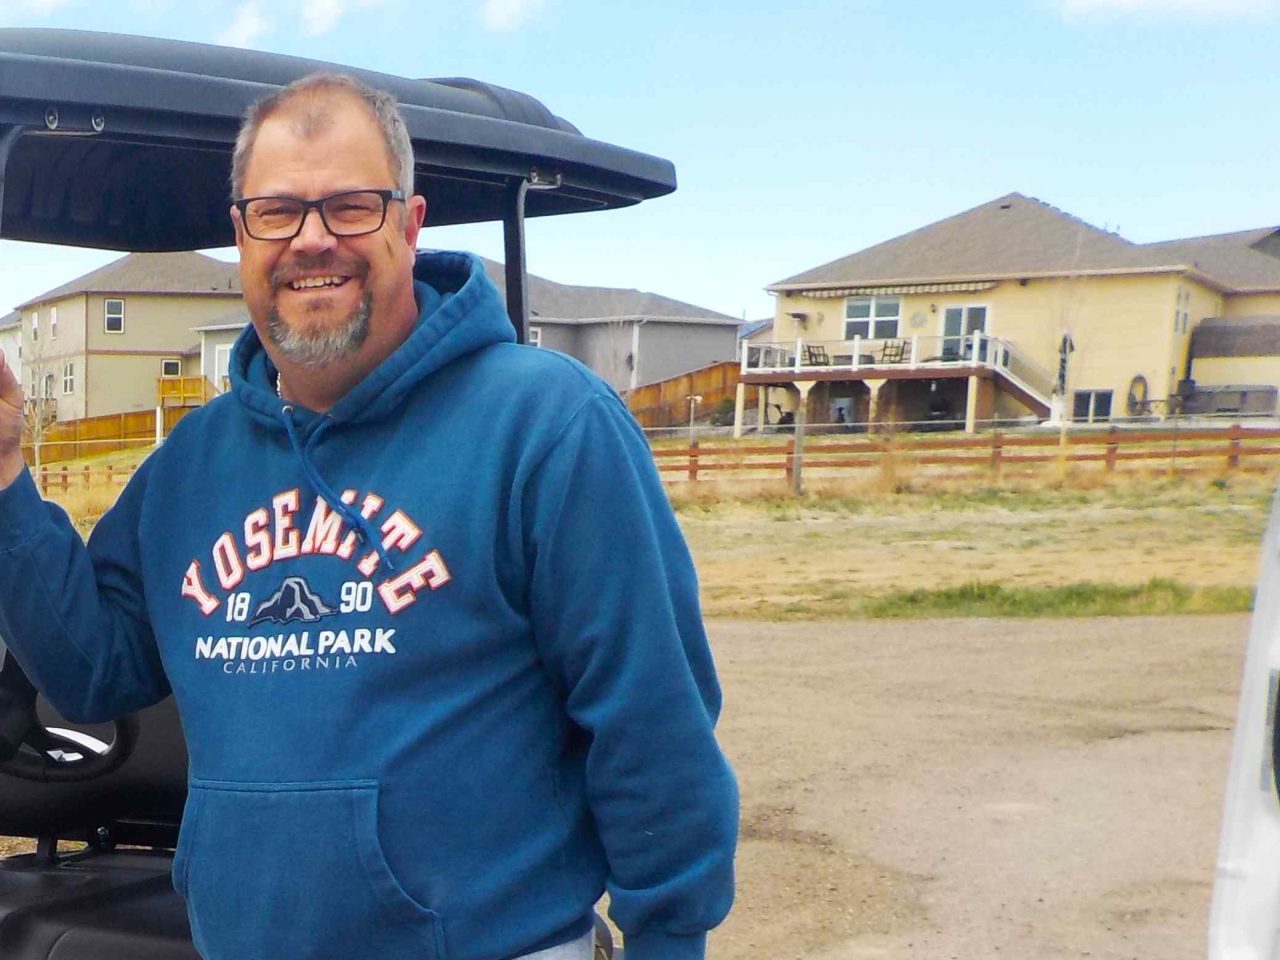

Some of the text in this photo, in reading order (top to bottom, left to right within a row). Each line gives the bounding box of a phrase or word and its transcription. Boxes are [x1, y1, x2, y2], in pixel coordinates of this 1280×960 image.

[181, 488, 451, 615] YOSEMITE
[226, 581, 373, 622] 18 90
[195, 628, 396, 660] NATIONAL PARK
[223, 655, 357, 674] CALIFORNIA
